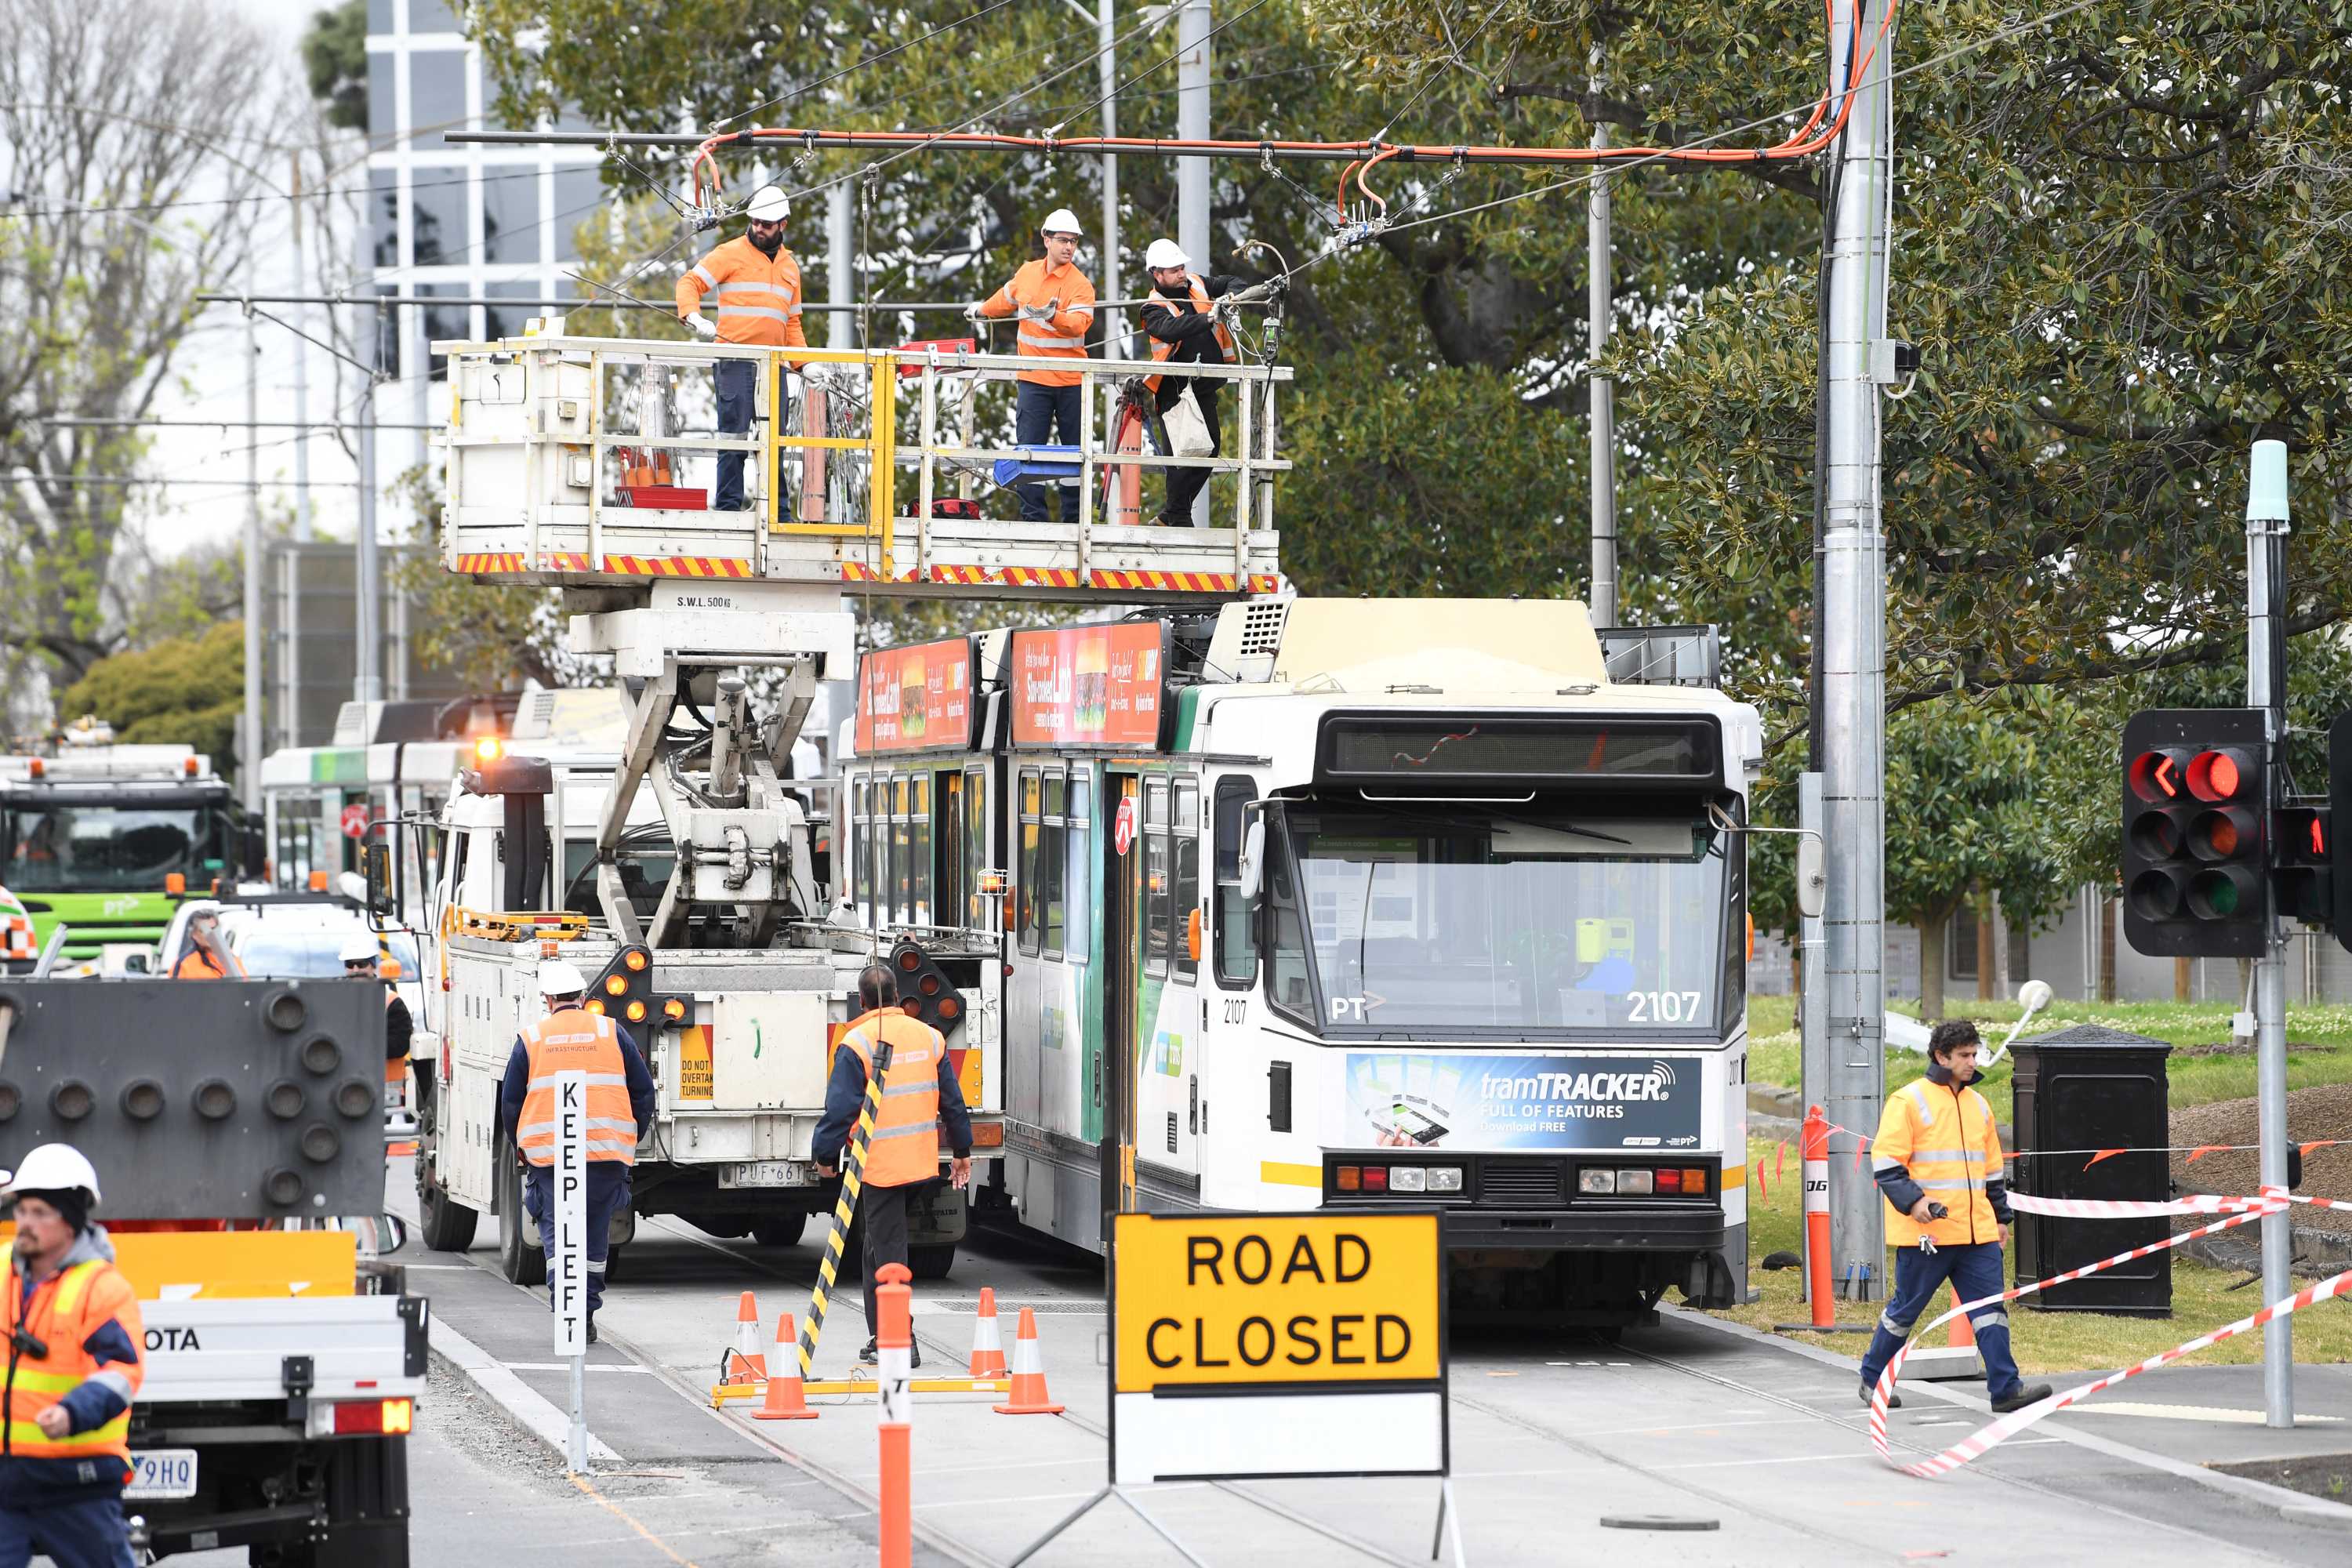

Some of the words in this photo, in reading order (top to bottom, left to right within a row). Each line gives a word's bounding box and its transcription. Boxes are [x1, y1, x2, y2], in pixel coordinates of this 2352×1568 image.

[1118, 804, 1132, 820] STOP
[1224, 998, 1247, 1025] 2107
[1627, 991, 1701, 1022] 2107
[546, 1045, 598, 1054] INFRASTRUCTURE
[681, 1059, 692, 1071] DO
[694, 1059, 710, 1071] NOT
[1481, 1105, 1518, 1117] FULL
[1522, 1105, 1543, 1117] OF
[1548, 1105, 1624, 1119] FEATURES
[1481, 1122, 1537, 1133] Download
[1539, 1123, 1566, 1132] FREE
[563, 1082, 579, 1202] KEEP
[1187, 1233, 1370, 1286] ROAD
[563, 1223, 578, 1343] LEFT
[1146, 1314, 1412, 1369] CLOSED
